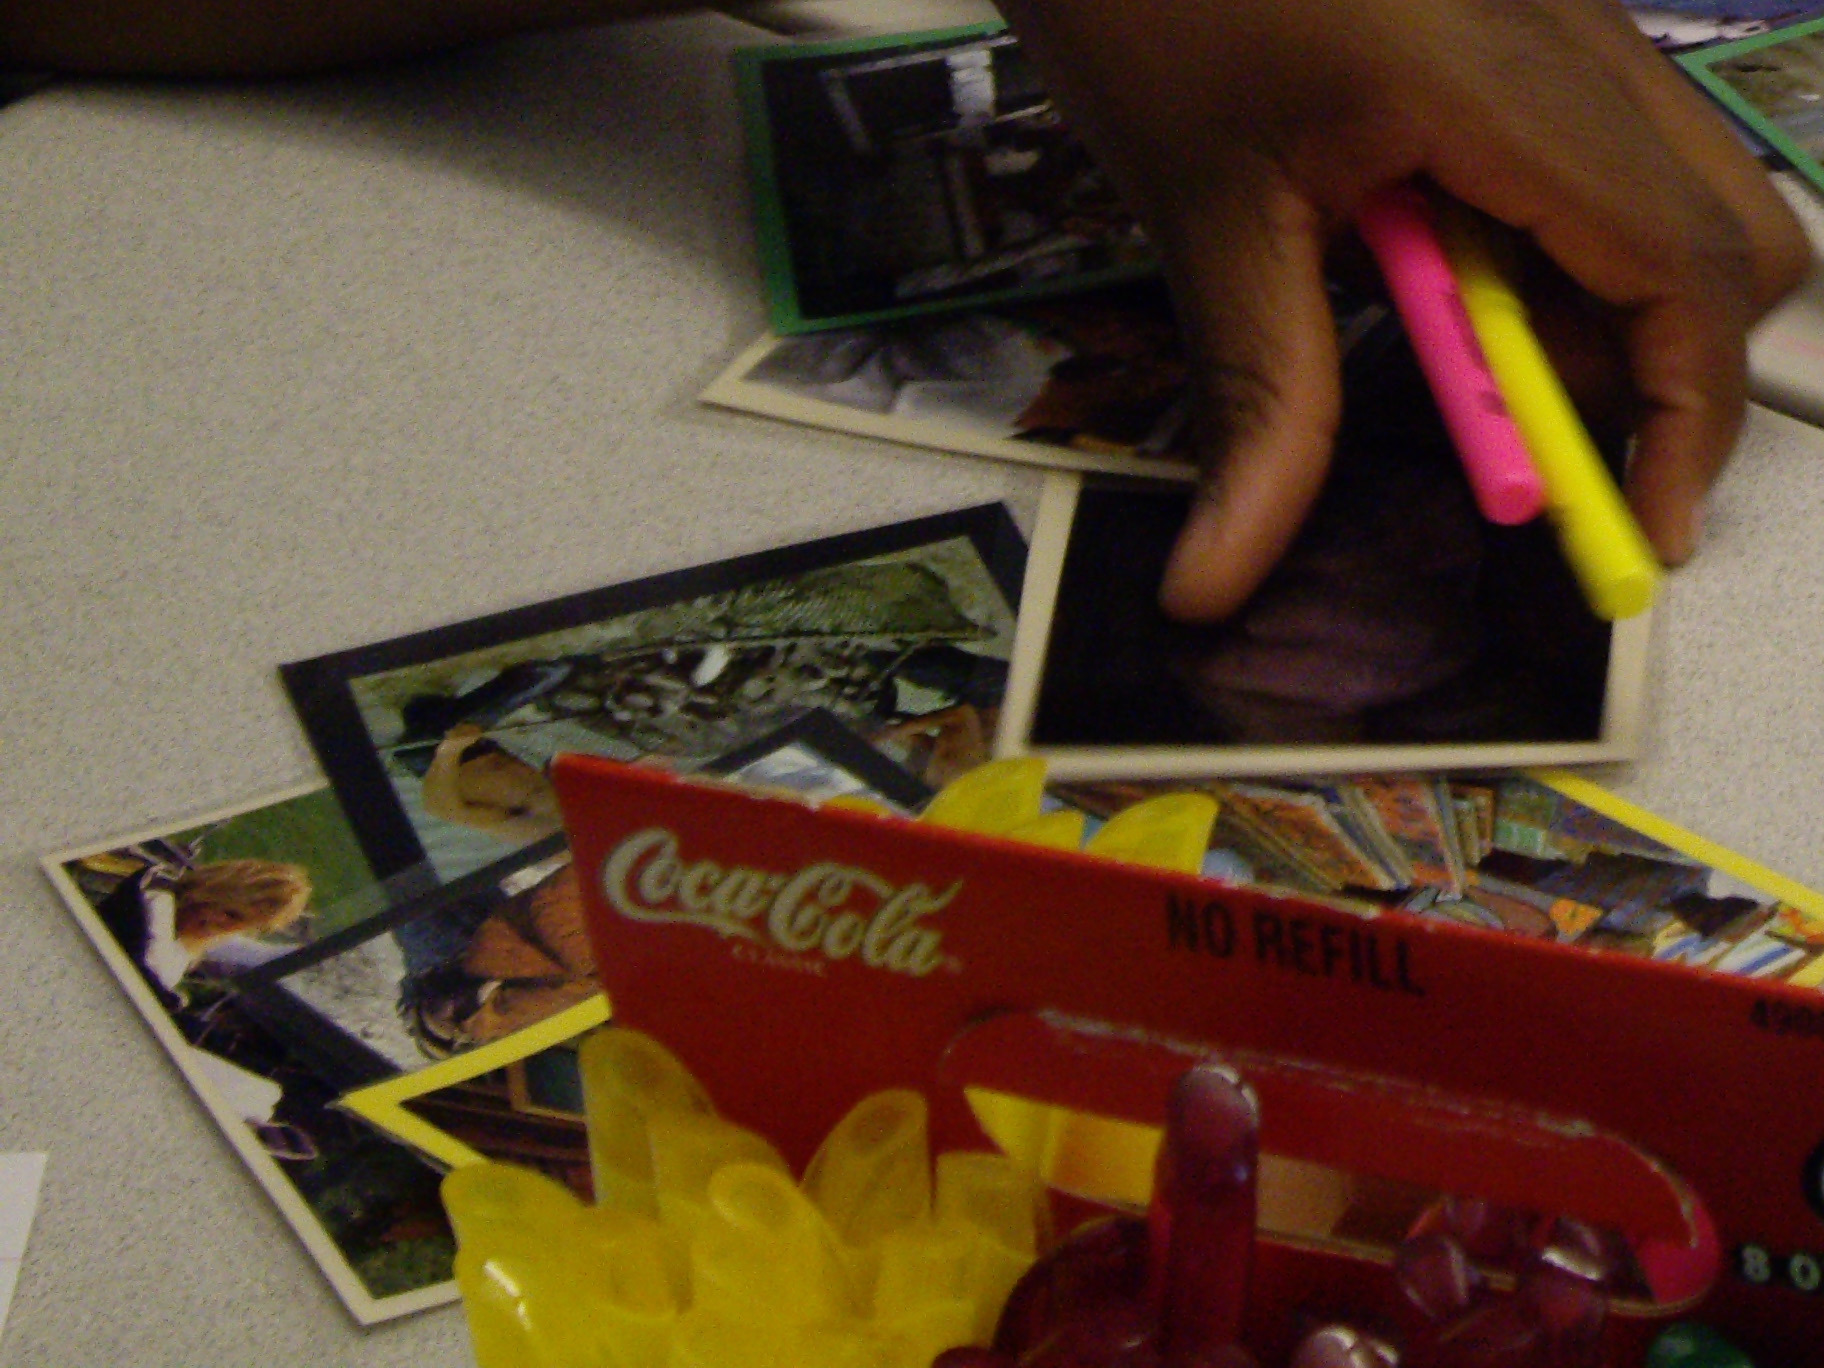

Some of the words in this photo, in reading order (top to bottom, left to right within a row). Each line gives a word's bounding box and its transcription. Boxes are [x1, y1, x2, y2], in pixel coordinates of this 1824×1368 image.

[605, 827, 963, 977] Coca-Cola
[1167, 893, 1235, 958] NO
[1253, 910, 1426, 996] REFILL
[1741, 1244, 1771, 1283] 8
